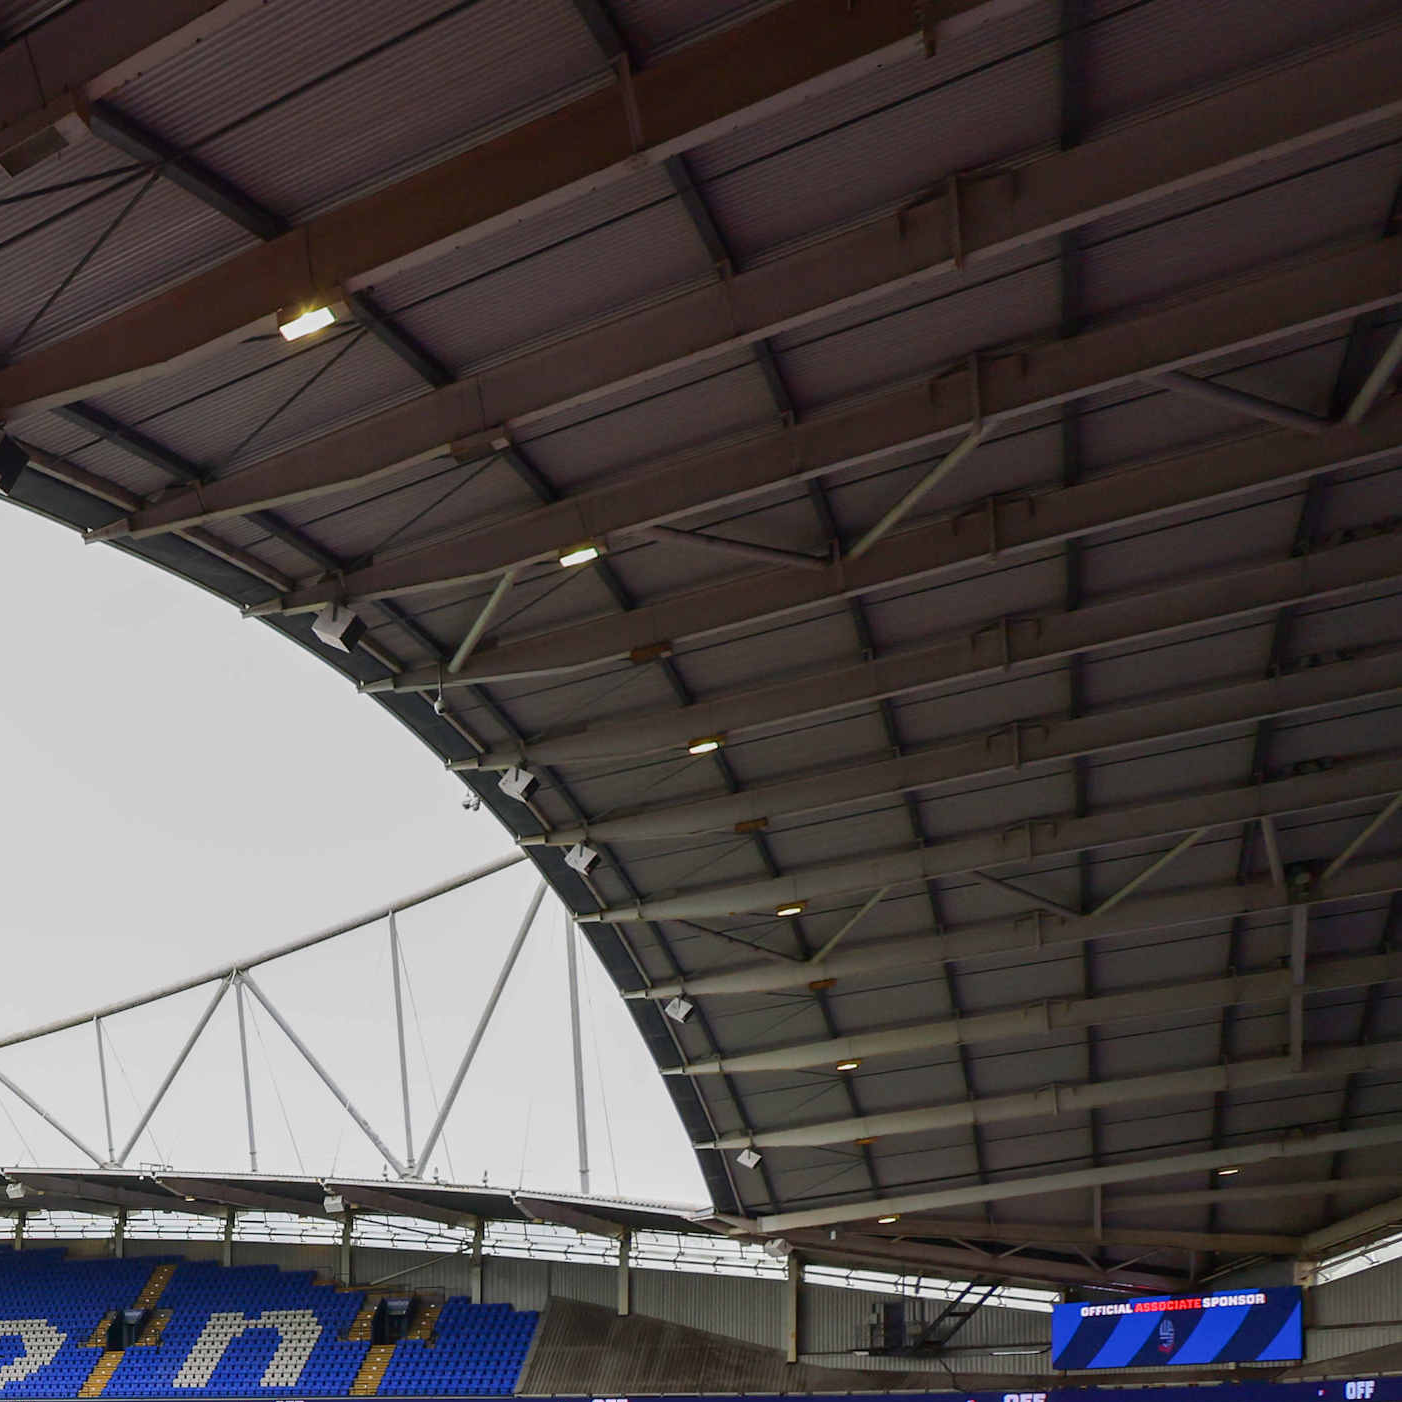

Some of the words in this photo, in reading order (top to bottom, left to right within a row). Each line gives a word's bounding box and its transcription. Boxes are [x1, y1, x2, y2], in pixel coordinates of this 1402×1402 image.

[1080, 1303, 1133, 1317] OFFICIAL
[1134, 1298, 1202, 1313] ASSOCIATE
[1202, 1293, 1266, 1308] SPONSOR
[1345, 1380, 1376, 1400] OFF
